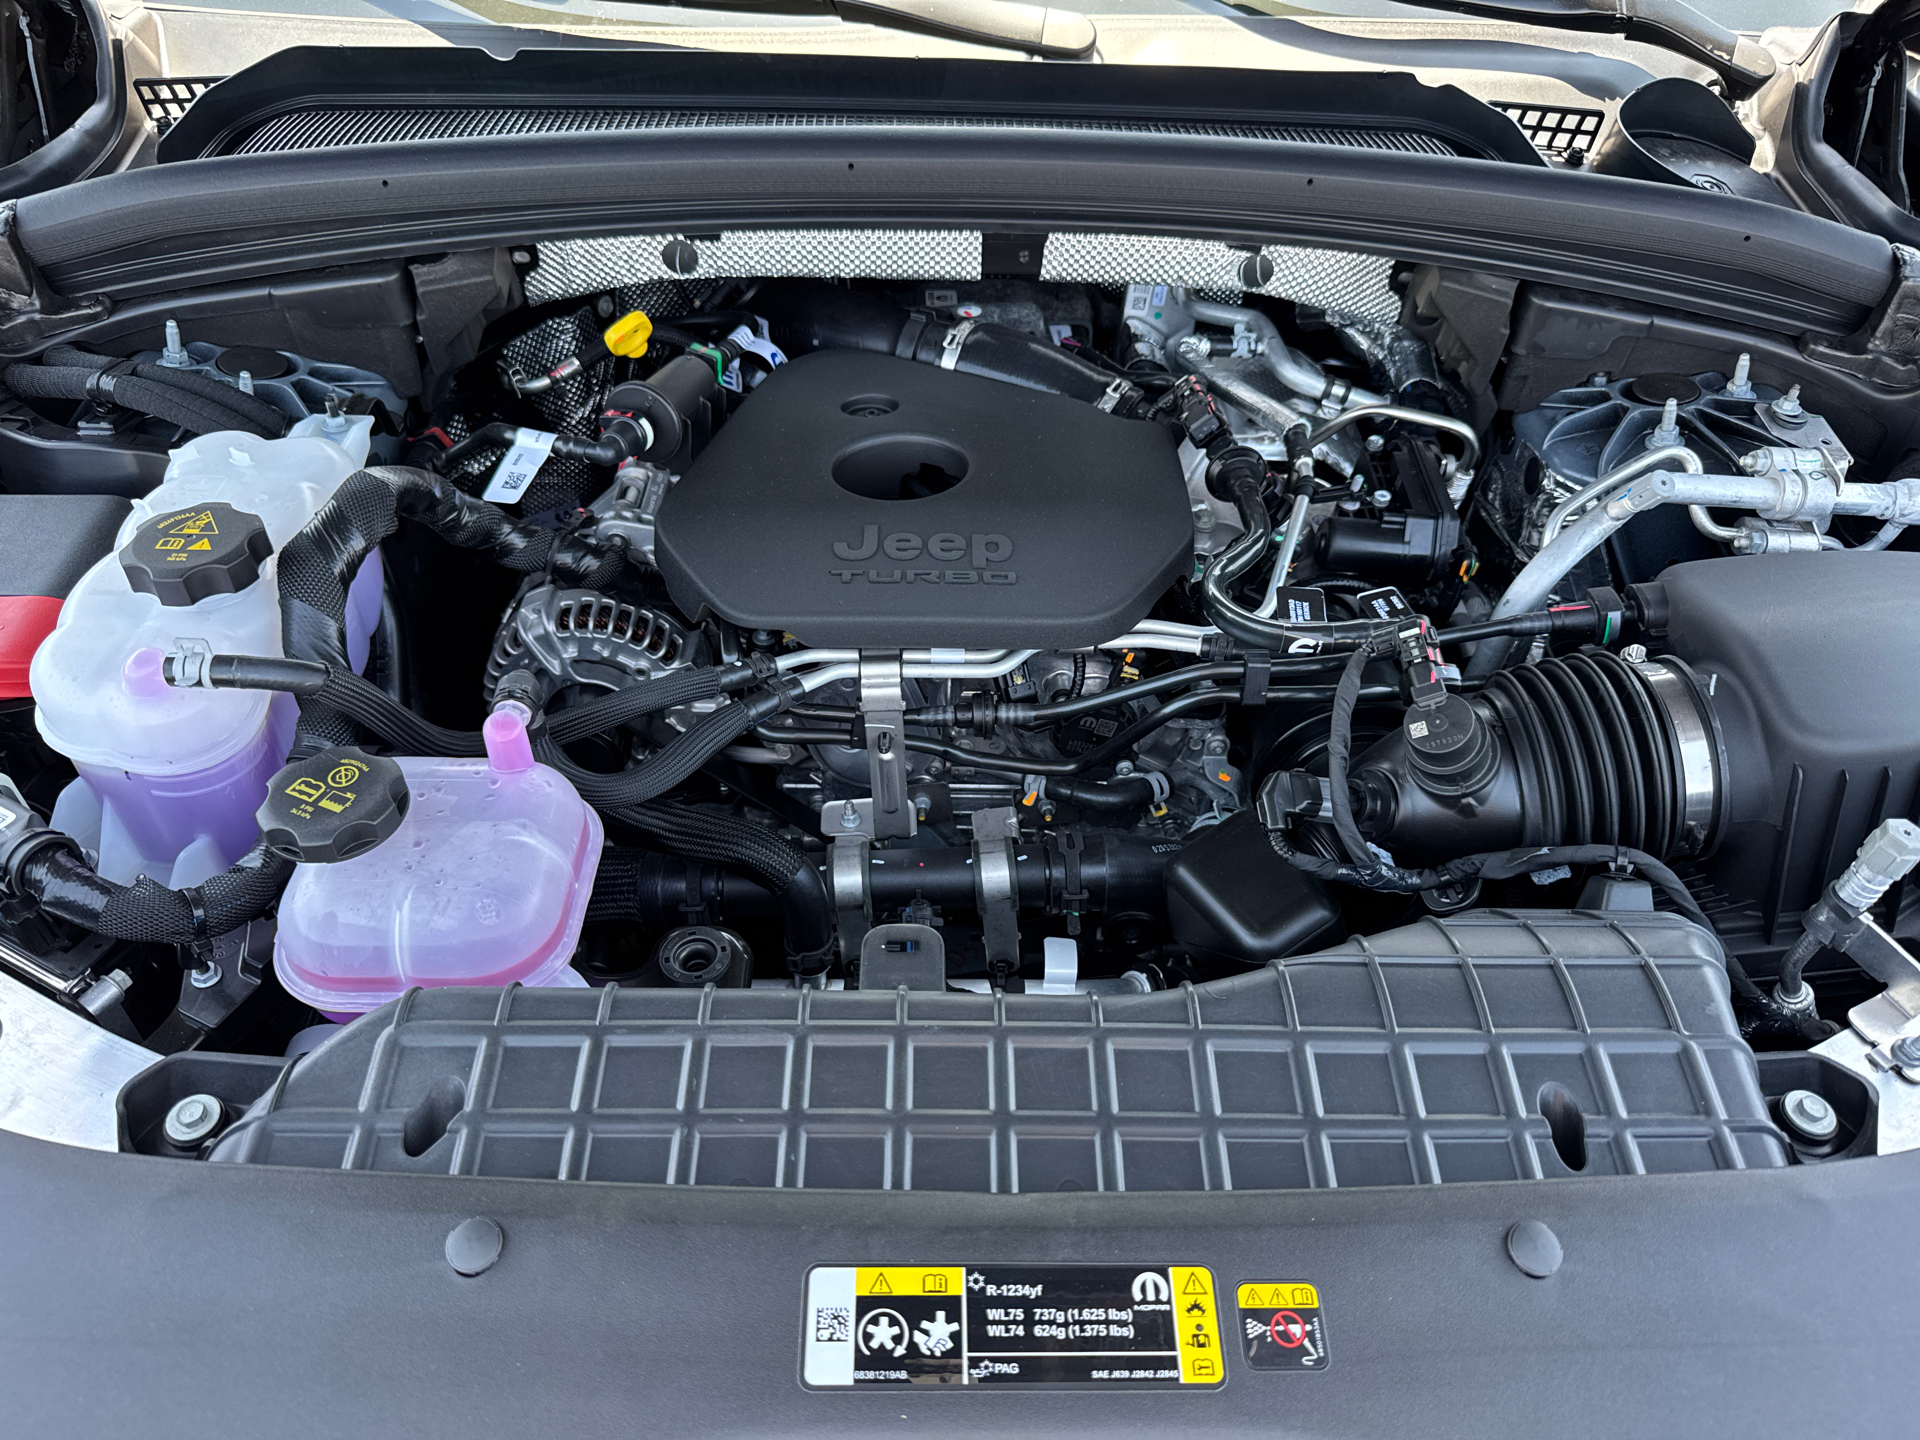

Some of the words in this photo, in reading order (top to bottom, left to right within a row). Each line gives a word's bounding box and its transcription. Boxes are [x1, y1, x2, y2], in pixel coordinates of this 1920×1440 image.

[833, 524, 1013, 570] Jeep
[829, 569, 1017, 585] TURBO
[300, 811, 312, 819] kPa
[304, 805, 315, 813] PSI
[985, 1284, 1044, 1299] R-1234yf
[986, 1308, 1025, 1321] WL75
[1033, 1308, 1065, 1323] 737g
[1067, 1308, 1107, 1323] (1.625
[1107, 1308, 1134, 1323] lbs)
[986, 1324, 1025, 1337] WL74
[1033, 1324, 1066, 1339] 624g
[1068, 1324, 1108, 1339] (1.375
[1109, 1324, 1135, 1339] lbs)
[993, 1362, 1020, 1374] PAG
[1091, 1369, 1110, 1379] SAE
[1110, 1369, 1130, 1379] J639
[1130, 1369, 1155, 1379] J2842
[1155, 1369, 1179, 1379] J2845
[853, 1370, 908, 1380] 68381219AB
